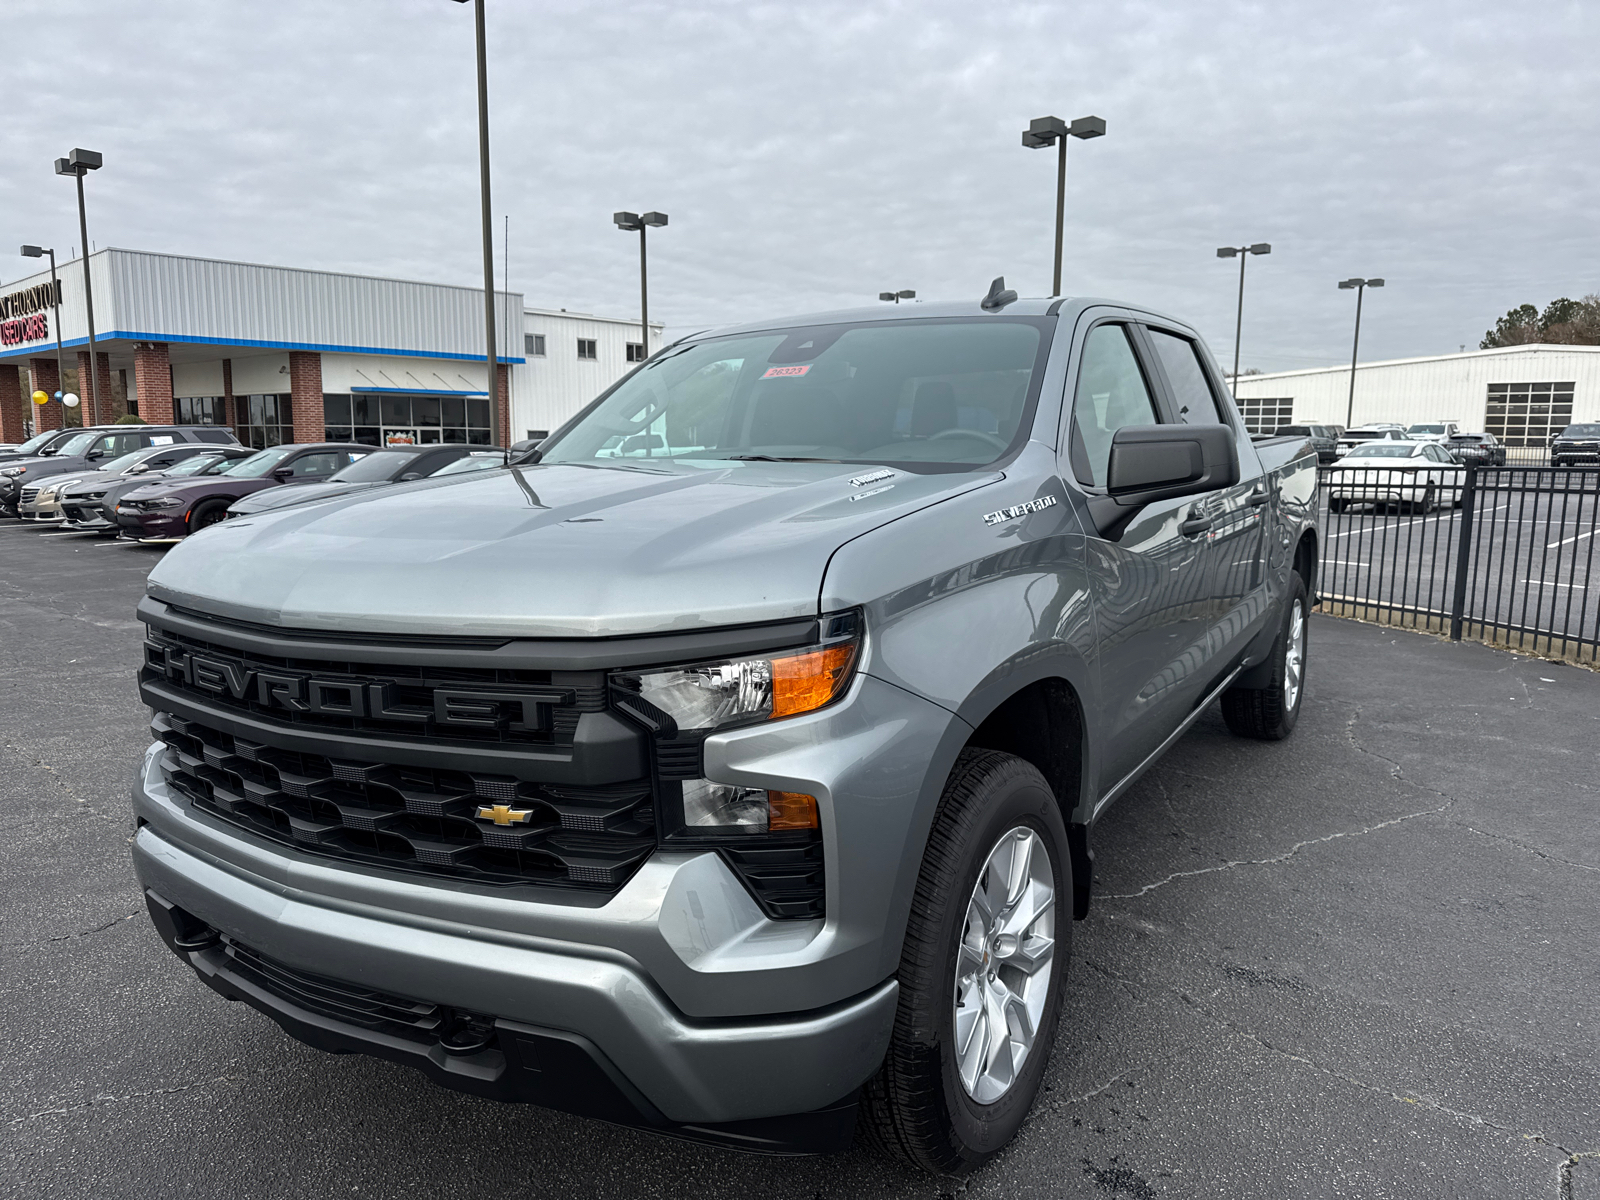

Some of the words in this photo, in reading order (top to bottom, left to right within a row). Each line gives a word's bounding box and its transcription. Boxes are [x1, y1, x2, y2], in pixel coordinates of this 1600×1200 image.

[0, 320, 21, 345] USED
[21, 313, 47, 341] CARS
[982, 494, 1058, 527] SILVERADO
[144, 639, 568, 730] CHEVROLET
